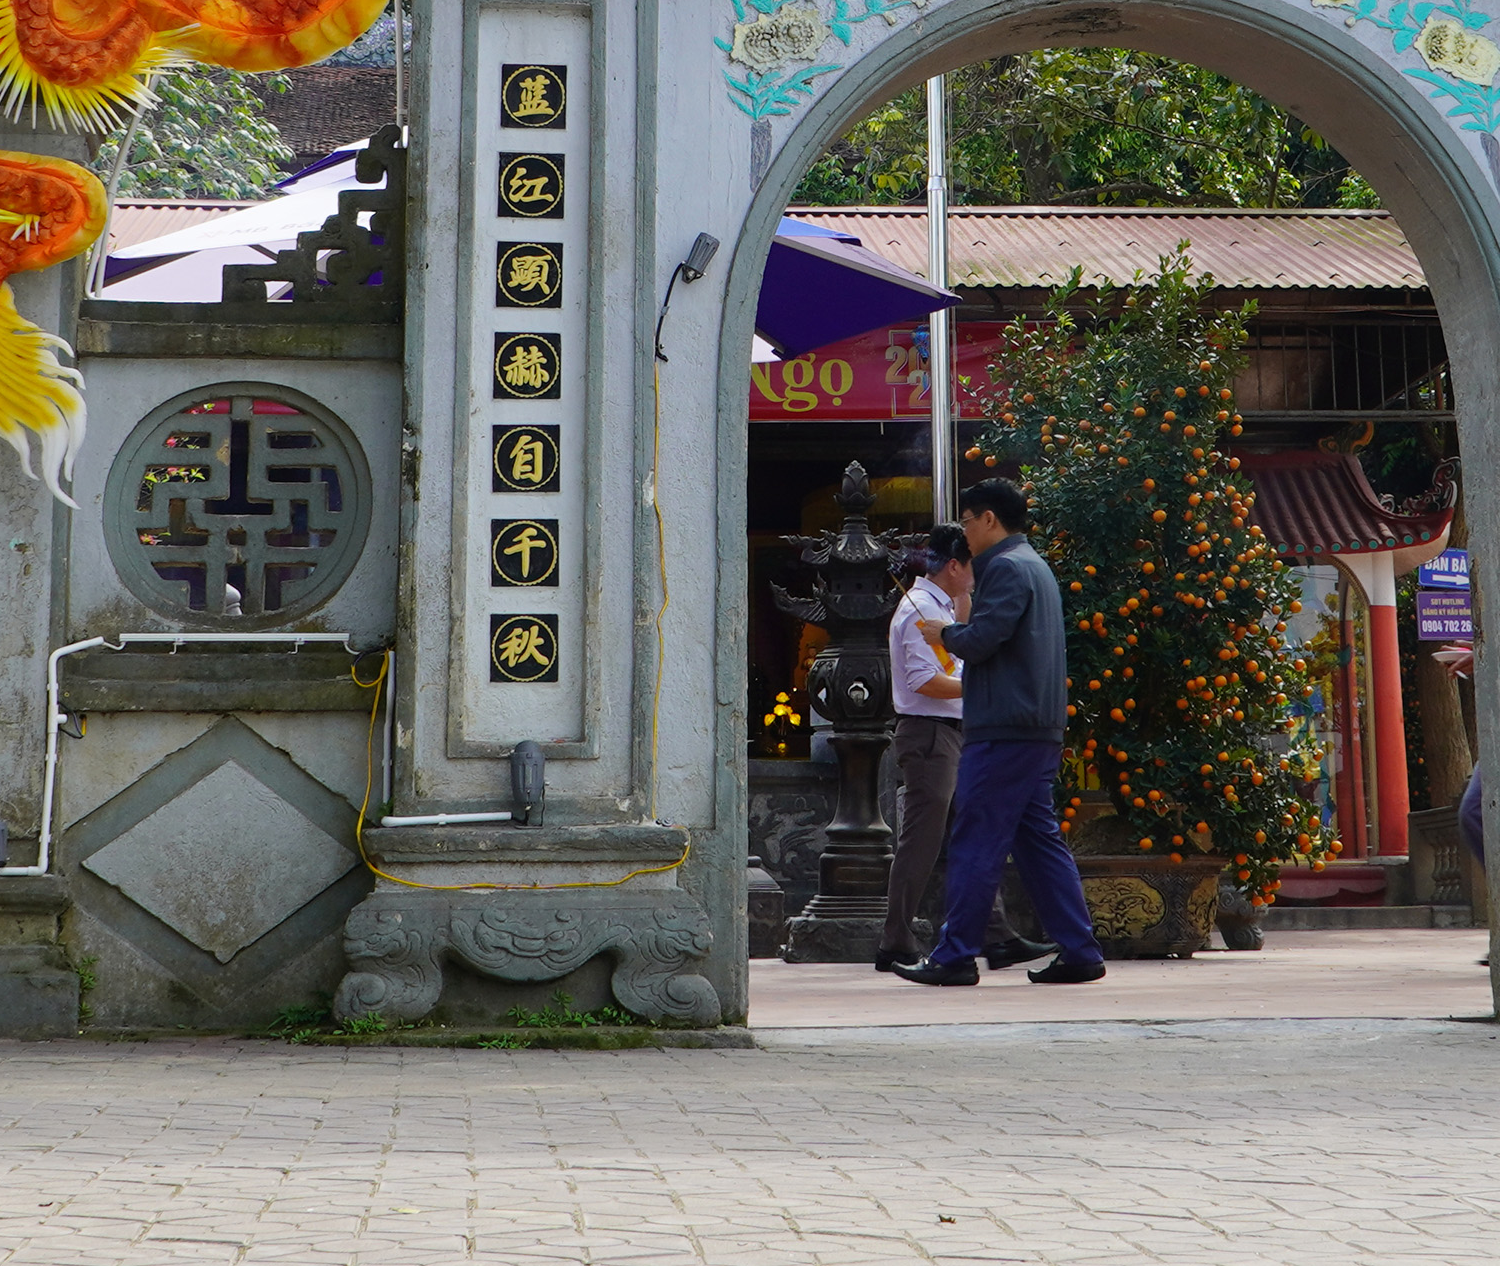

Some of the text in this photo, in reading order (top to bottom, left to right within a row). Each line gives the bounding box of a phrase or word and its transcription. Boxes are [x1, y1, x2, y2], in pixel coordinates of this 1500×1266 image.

[1451, 556, 1468, 573] BÀ
[1422, 619, 1473, 633] 0904 702 26
